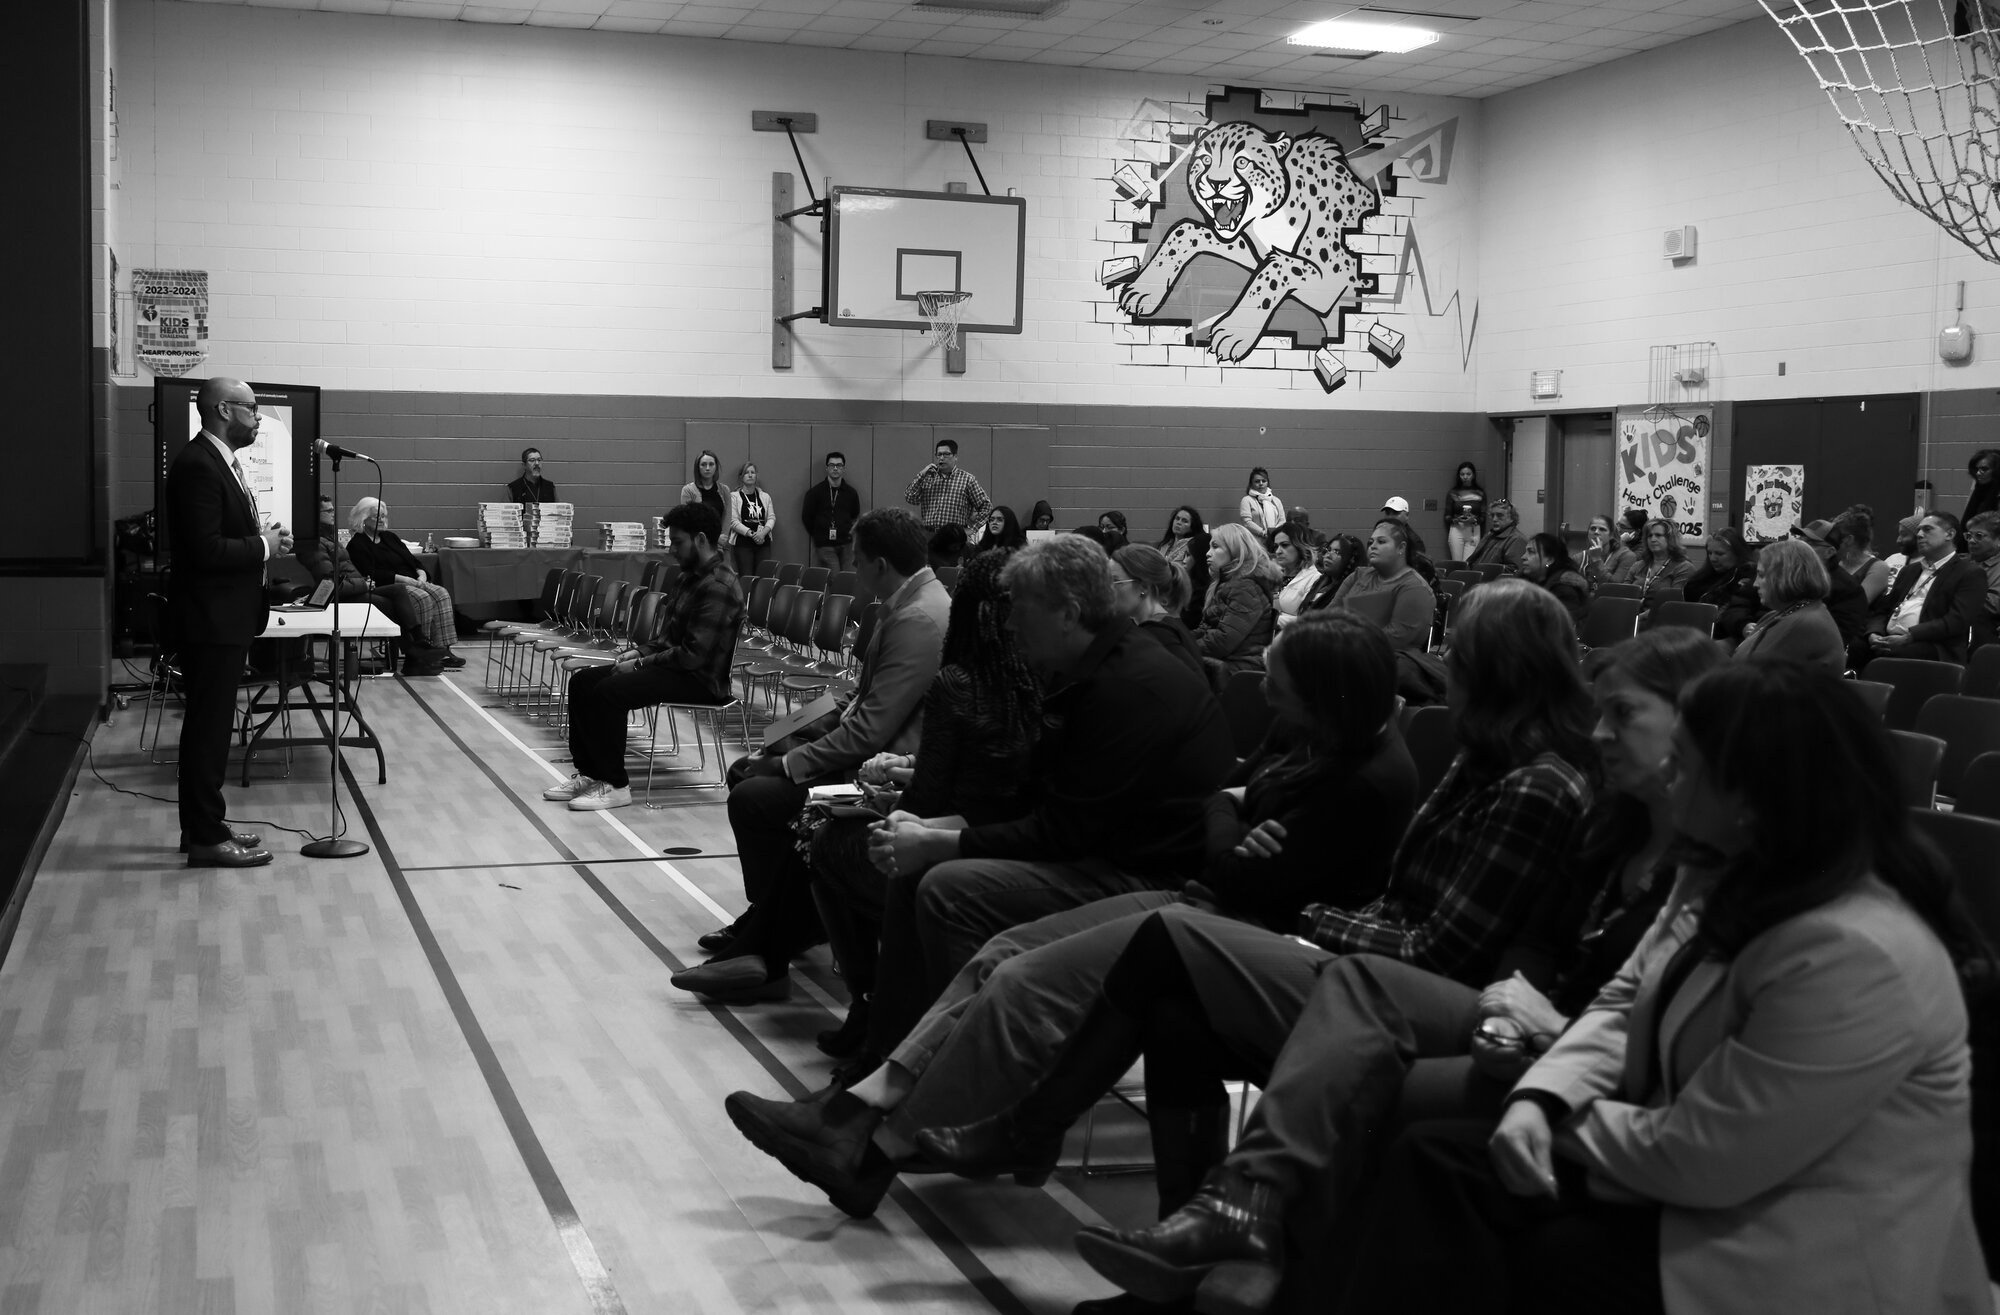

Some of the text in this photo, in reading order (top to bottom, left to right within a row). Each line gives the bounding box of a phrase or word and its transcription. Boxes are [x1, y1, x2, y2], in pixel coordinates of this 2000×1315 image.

[145, 286, 196, 295] 2023-2024
[160, 317, 189, 327] KIDS
[1621, 425, 1697, 484] KIDS
[1622, 474, 1701, 507] Heart Challenge
